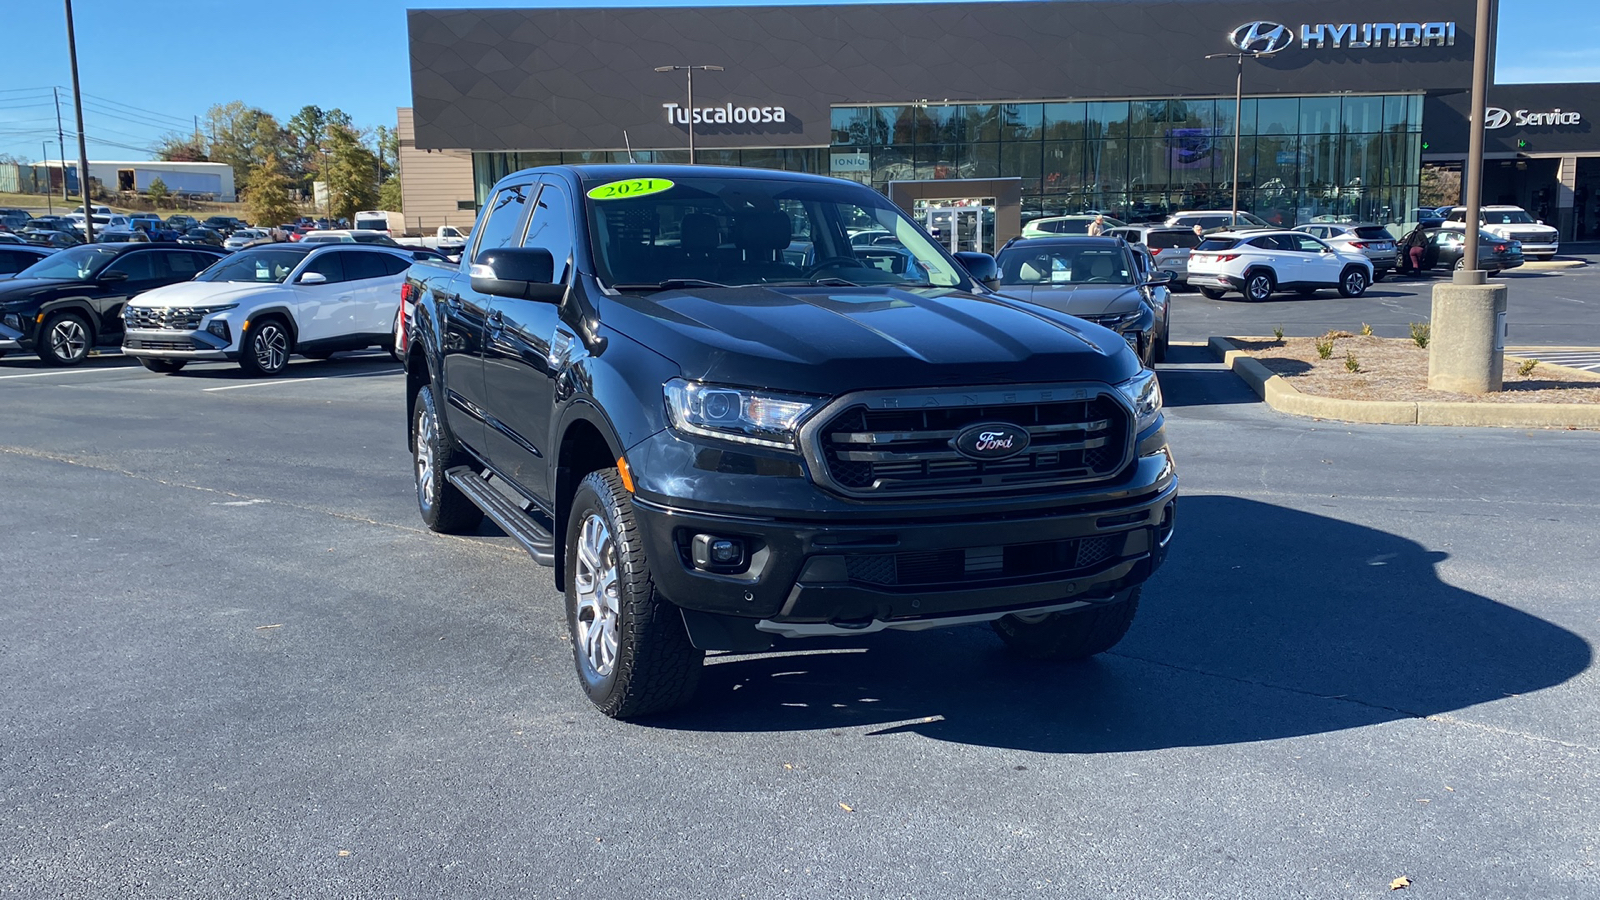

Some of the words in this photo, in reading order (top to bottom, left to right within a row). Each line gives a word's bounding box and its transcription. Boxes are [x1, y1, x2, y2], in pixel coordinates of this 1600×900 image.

[1301, 22, 1455, 48] HYUNDAI
[662, 102, 786, 124] Tuscaloosa
[1515, 108, 1581, 126] Service
[604, 180, 654, 197] 2021
[975, 431, 1014, 451] Ford
